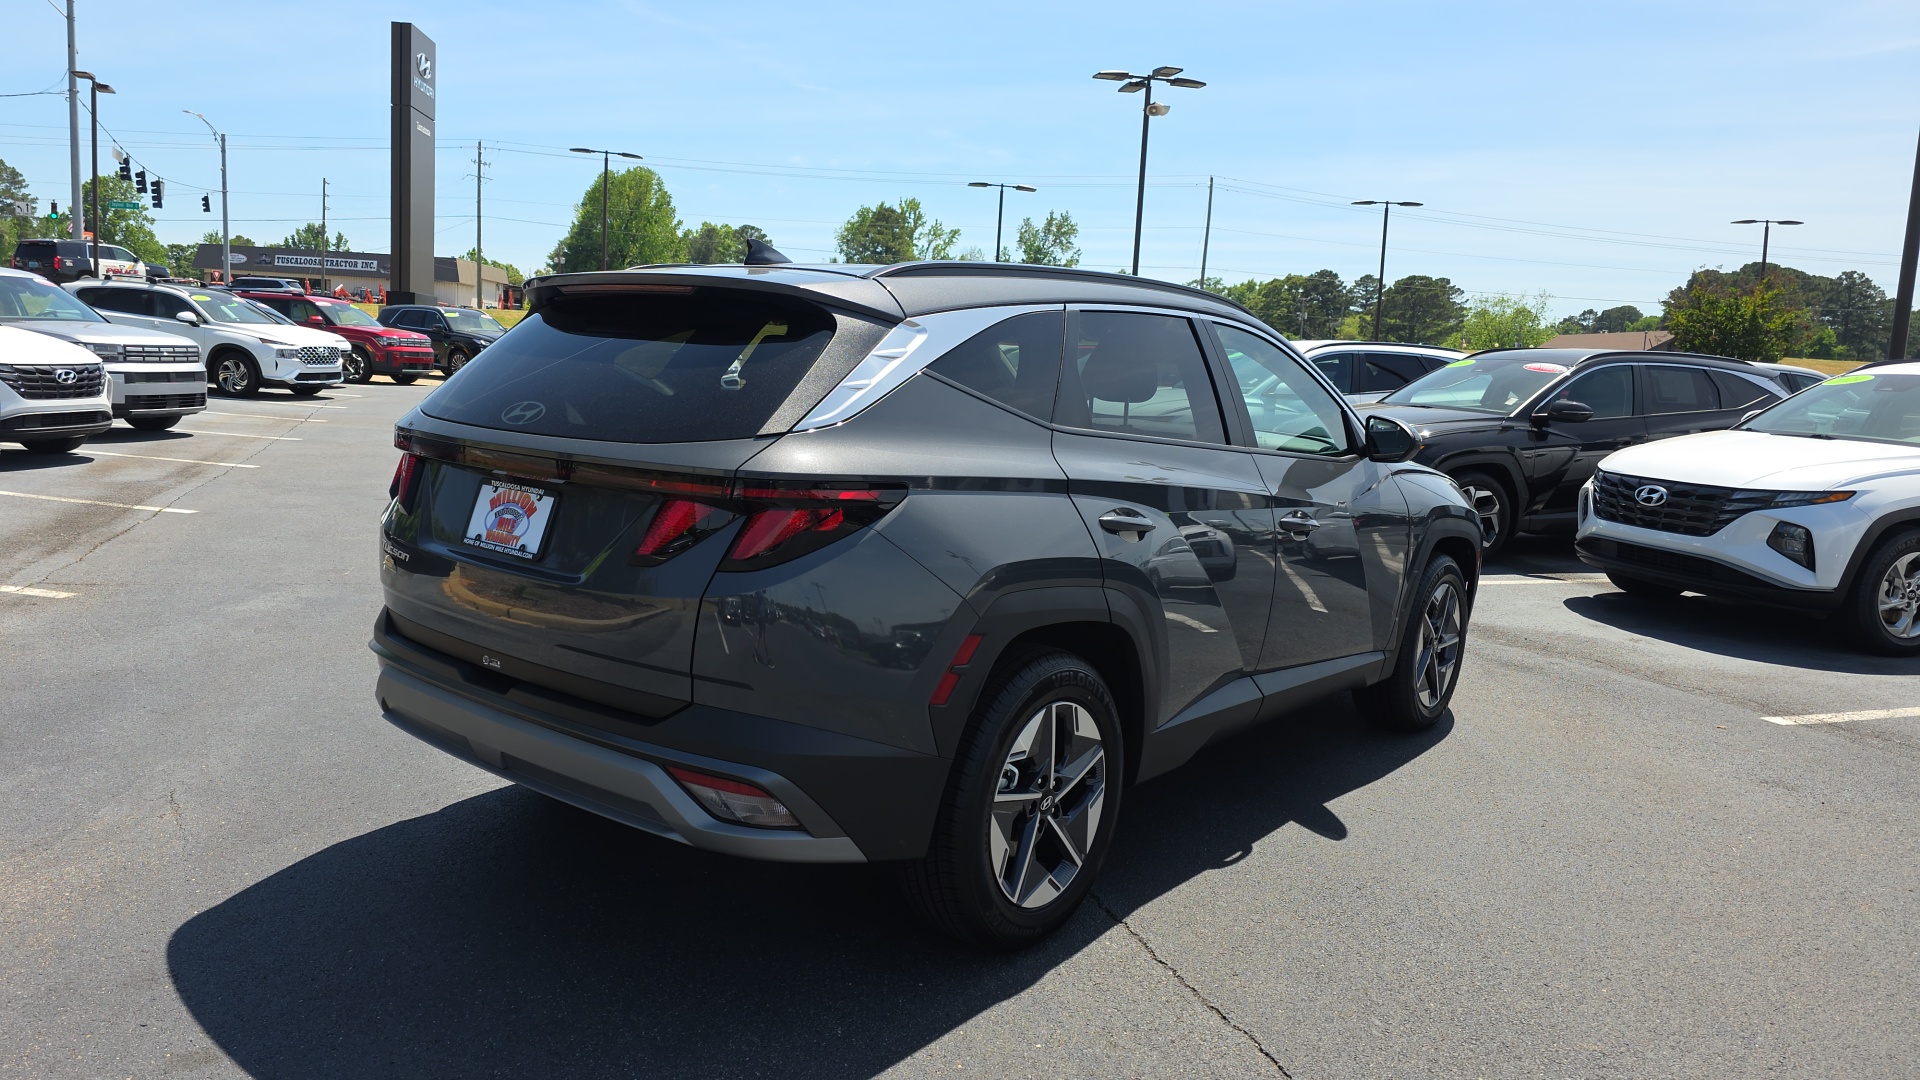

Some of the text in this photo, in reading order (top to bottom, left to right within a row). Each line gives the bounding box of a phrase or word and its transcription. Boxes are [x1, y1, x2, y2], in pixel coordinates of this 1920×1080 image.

[105, 267, 139, 275] POLICE
[276, 256, 376, 270] TUSCALOOSA TRACTOR INC.
[491, 480, 545, 495] TUSCALOOSA HYUNDAI
[489, 489, 537, 519] MILLION
[496, 516, 517, 533] MILE
[485, 529, 520, 547] WARRANTY
[463, 538, 474, 546] HOME
[480, 541, 495, 550] MILLION
[495, 545, 504, 553] MILE
[504, 547, 533, 559] HYUNDAI.COM
[1051, 671, 1110, 705] VELOCITY
